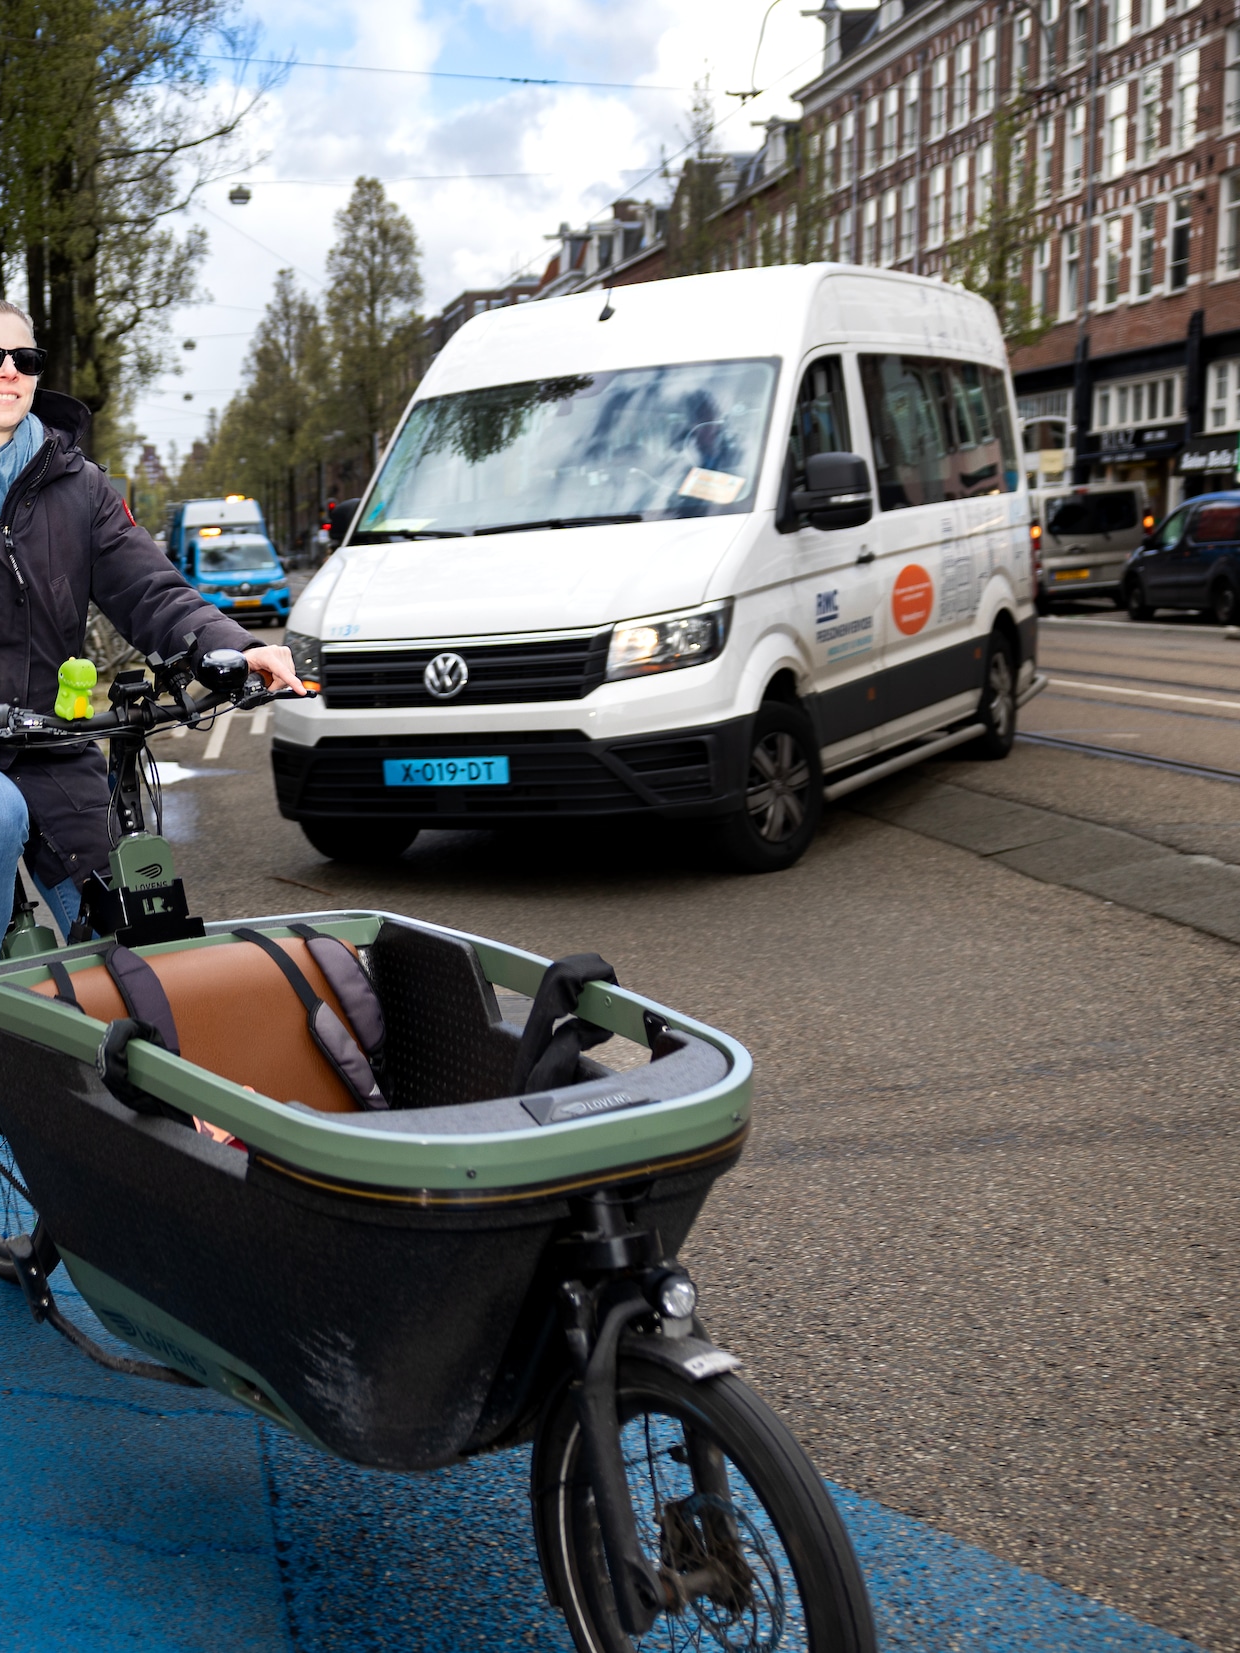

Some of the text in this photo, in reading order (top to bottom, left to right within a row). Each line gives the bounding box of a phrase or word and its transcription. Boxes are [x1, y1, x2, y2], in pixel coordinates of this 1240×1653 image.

[402, 761, 495, 782] X-019-DT
[586, 1094, 631, 1111] LOVENS
[135, 1325, 207, 1376] LOVENS
